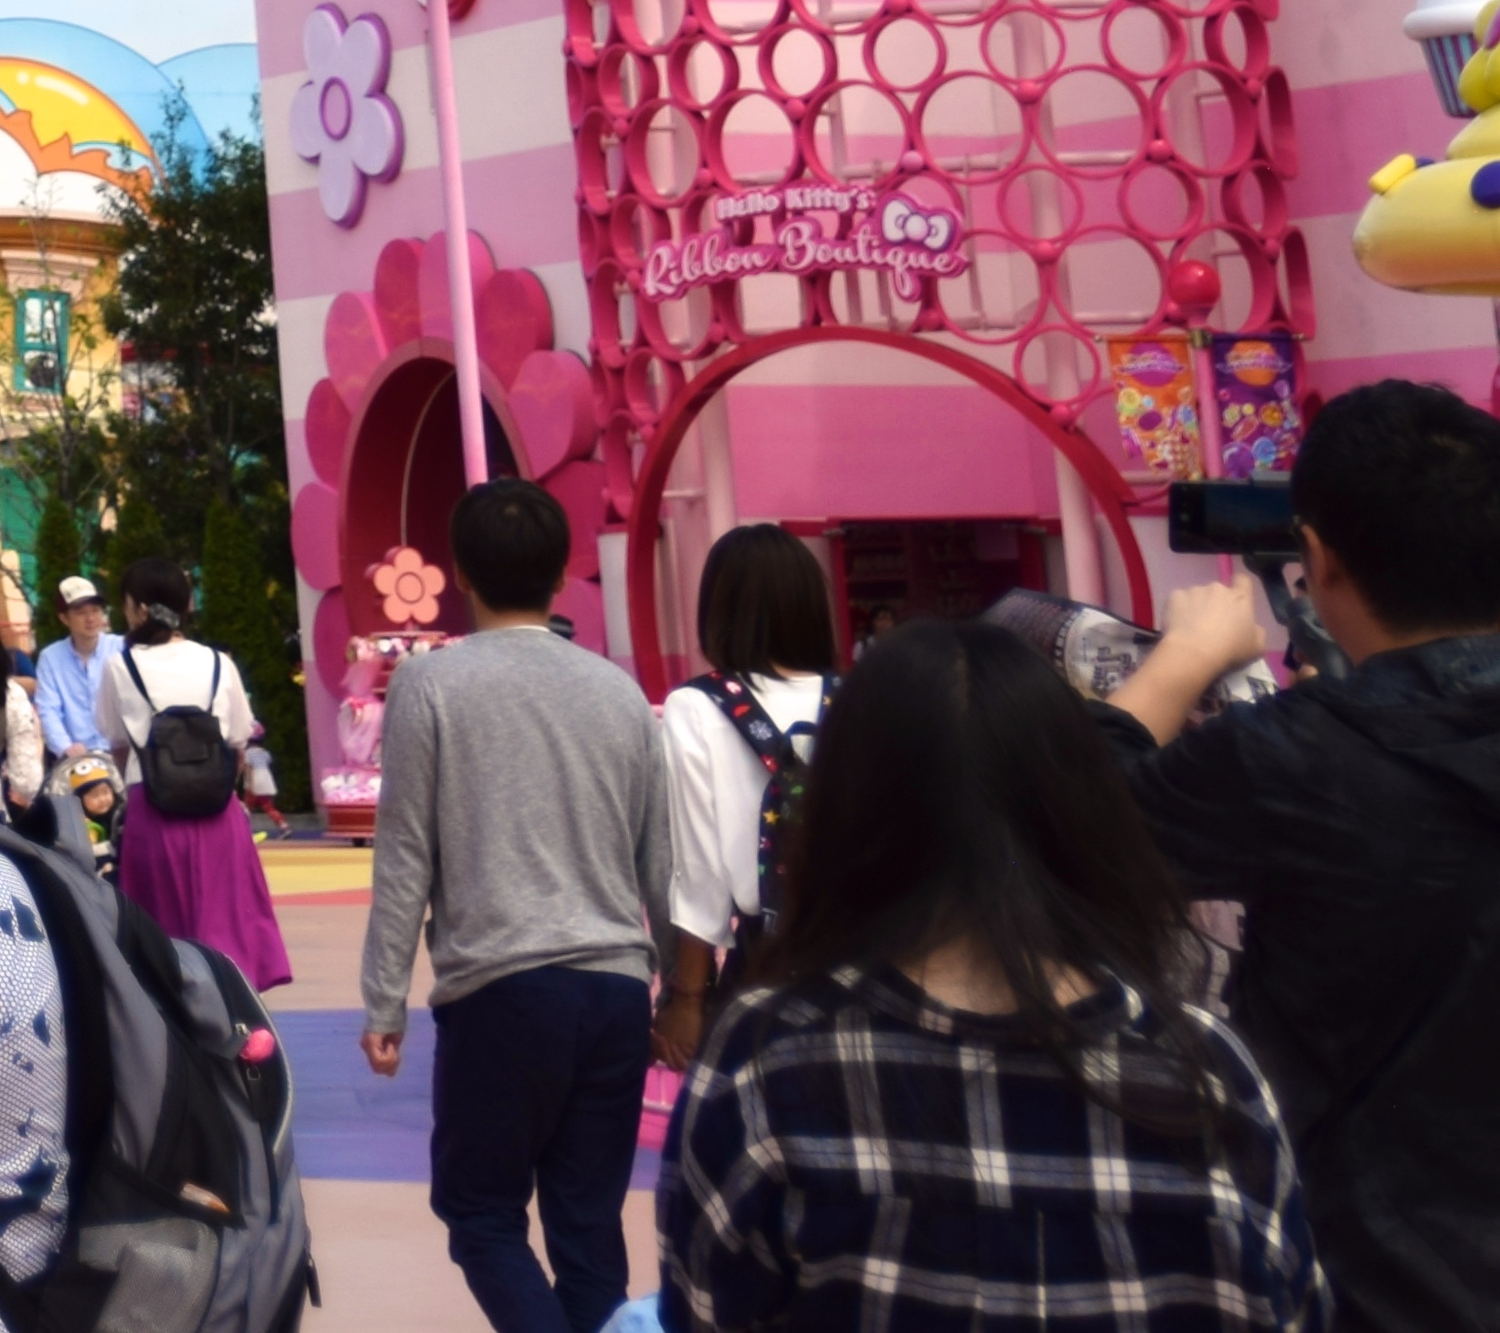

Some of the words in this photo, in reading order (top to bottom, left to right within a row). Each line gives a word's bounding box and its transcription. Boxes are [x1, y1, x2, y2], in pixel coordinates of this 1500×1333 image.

[717, 191, 781, 220] Hello
[785, 187, 872, 211] Kitty's
[645, 233, 771, 296] Ribbon
[777, 219, 963, 298] Boutique
